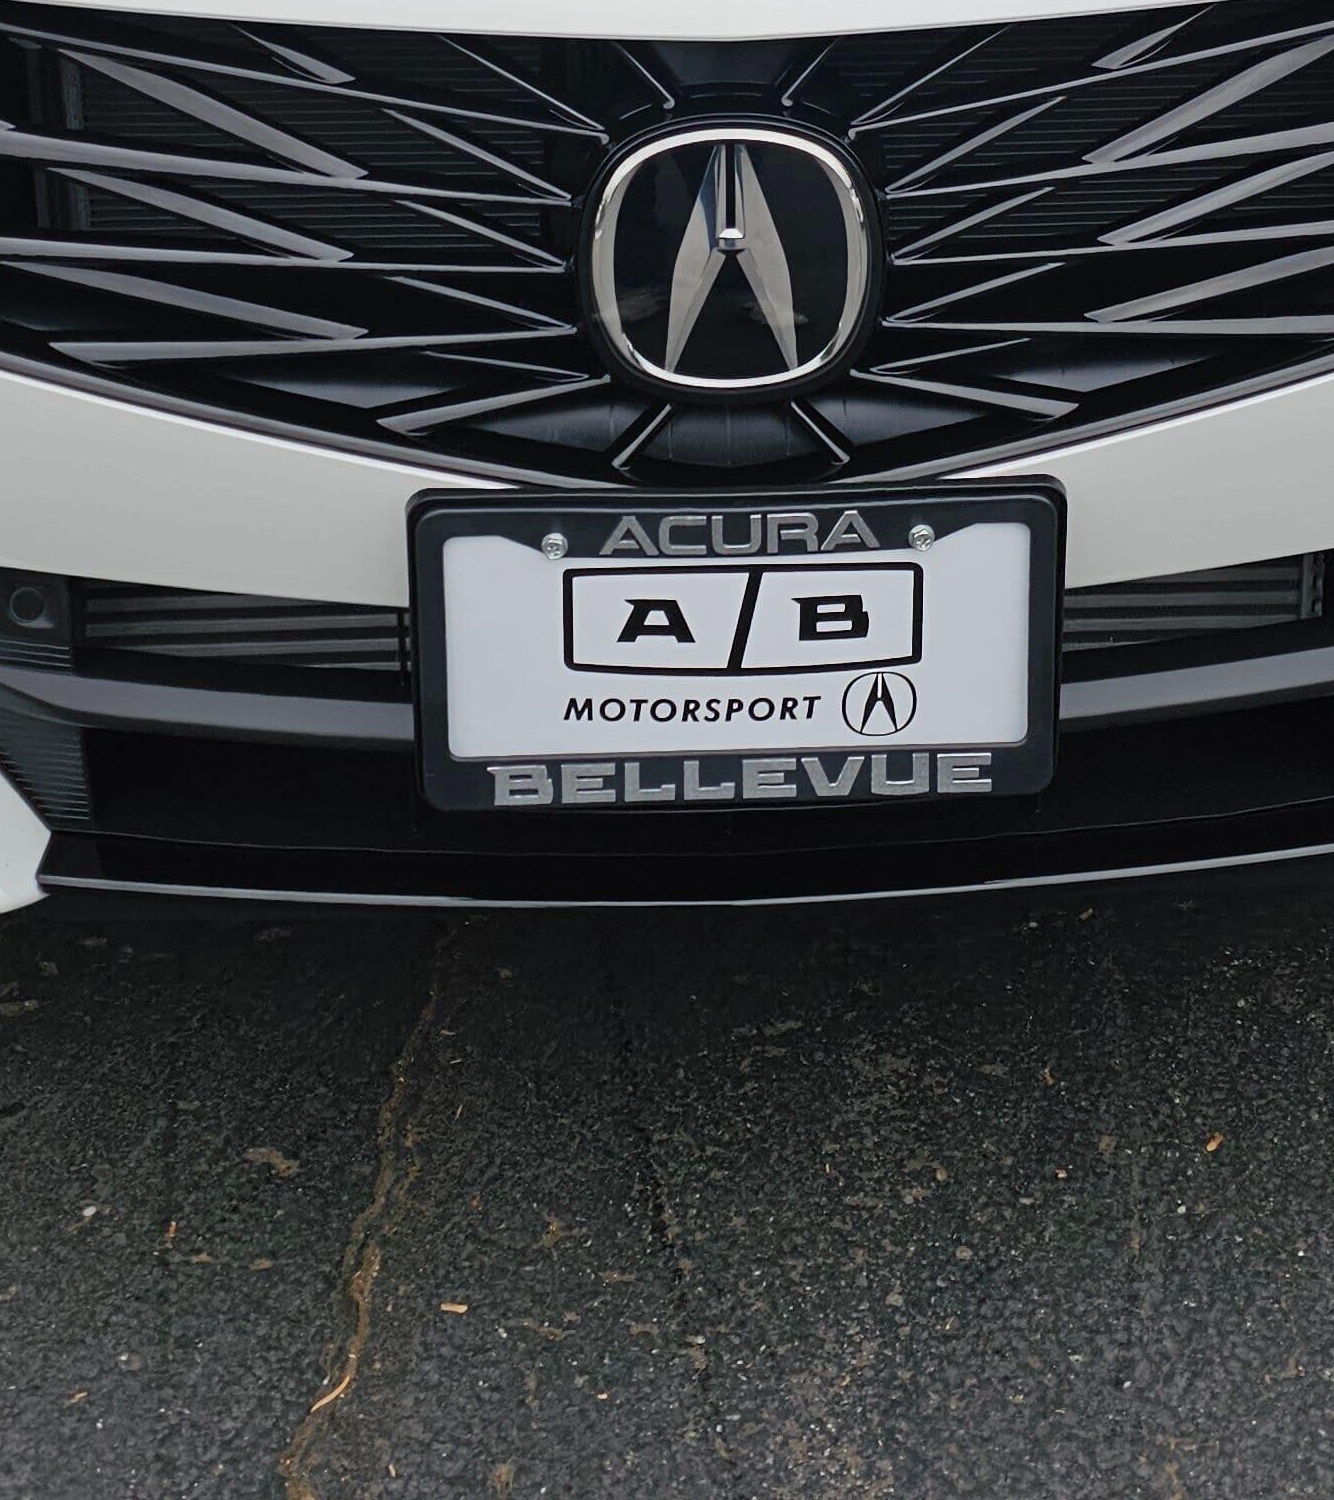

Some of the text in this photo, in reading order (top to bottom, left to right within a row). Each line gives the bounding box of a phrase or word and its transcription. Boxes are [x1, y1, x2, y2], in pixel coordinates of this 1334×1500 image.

[598, 509, 882, 557] ACURA
[563, 695, 822, 723] MOTORSPORT
[486, 752, 993, 807] BELLEVUE
